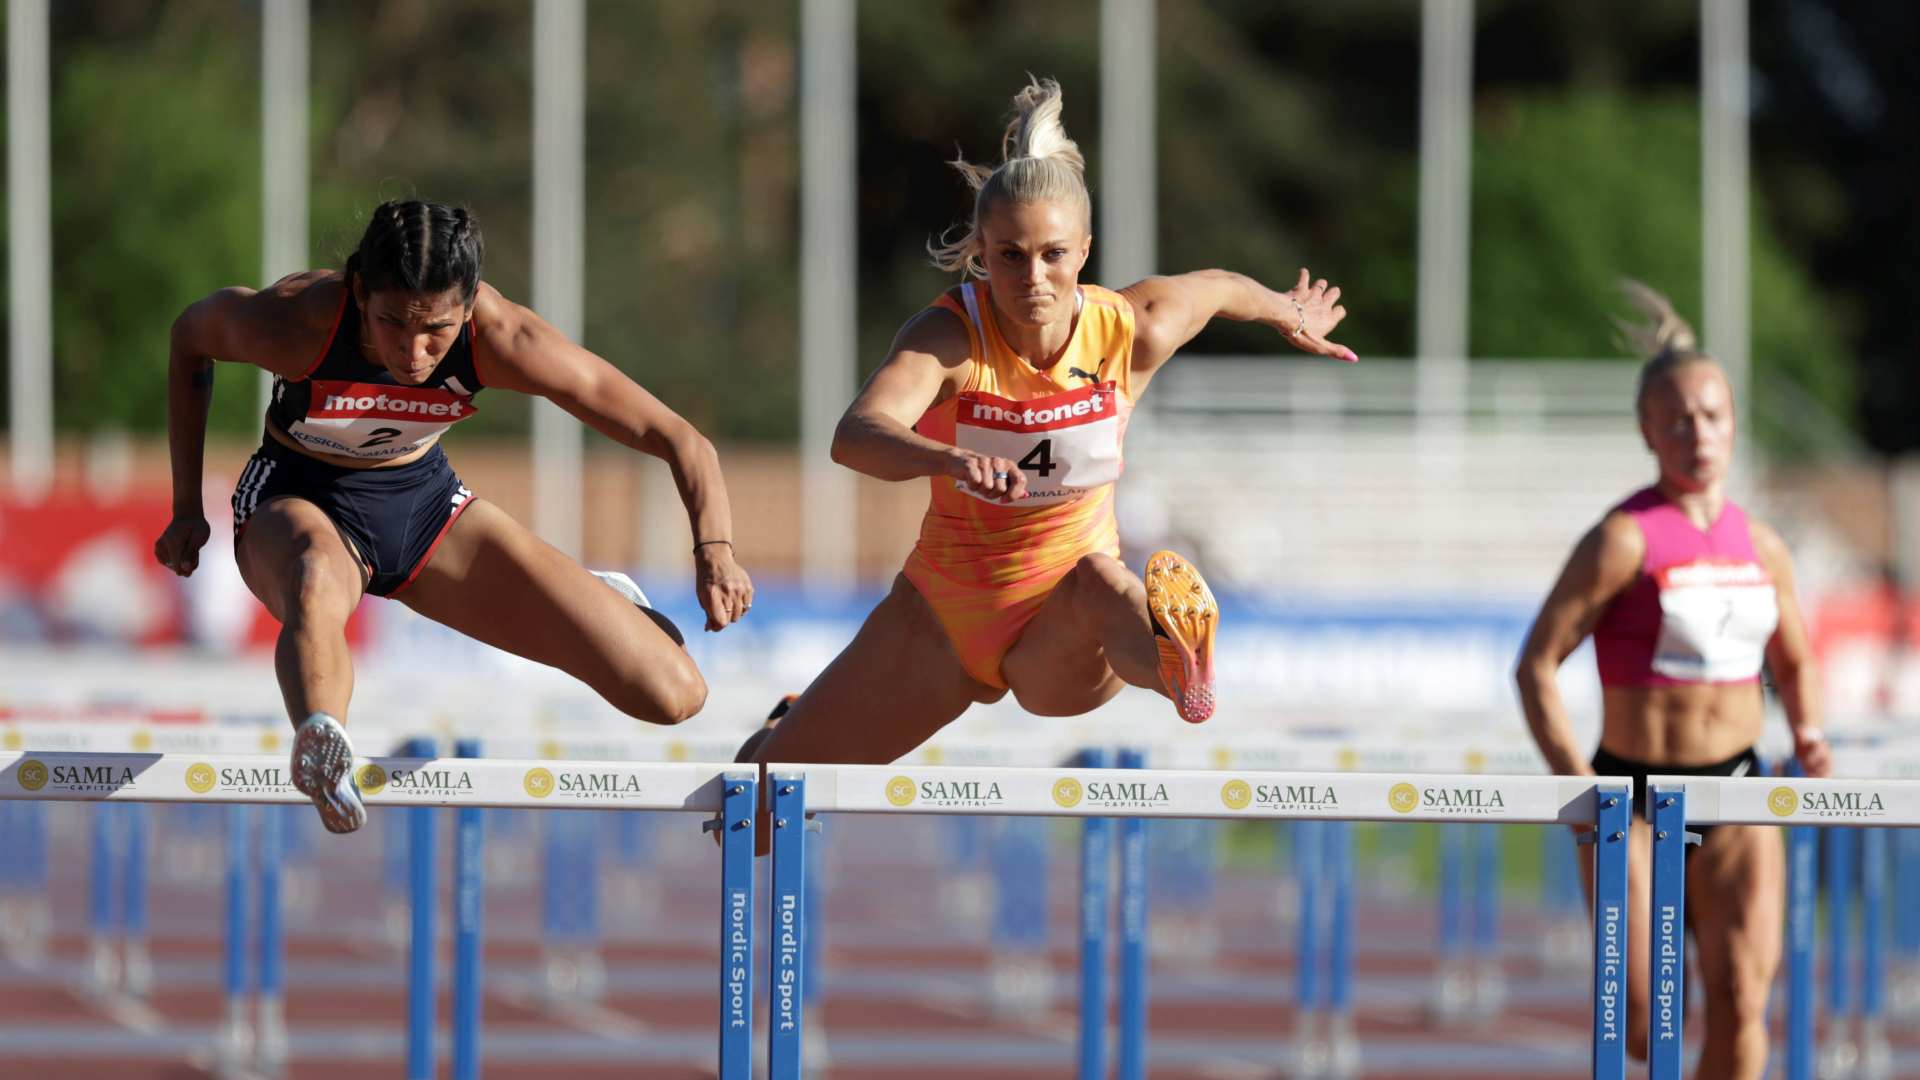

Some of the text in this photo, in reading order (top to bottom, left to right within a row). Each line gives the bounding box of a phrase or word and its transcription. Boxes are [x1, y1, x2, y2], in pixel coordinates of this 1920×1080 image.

[325, 394, 463, 417] motonet
[973, 394, 1104, 426] motonet
[358, 428, 402, 448] 2
[1017, 439, 1057, 477] 4
[53, 766, 136, 785] SAMLA
[391, 769, 473, 789] SAMLA
[559, 773, 641, 793] SAMLA
[920, 781, 1003, 800] SAMLA
[1087, 782, 1169, 801] SAMLA
[1256, 785, 1338, 804] SAMLA
[1423, 788, 1505, 807] SAMLA
[1802, 792, 1885, 810] SAMLA
[729, 893, 747, 1028] nordic Sport
[778, 895, 797, 1031] nordic Sport
[1601, 906, 1620, 1041] nordic Sport
[1657, 905, 1677, 1041] nordic Sport
